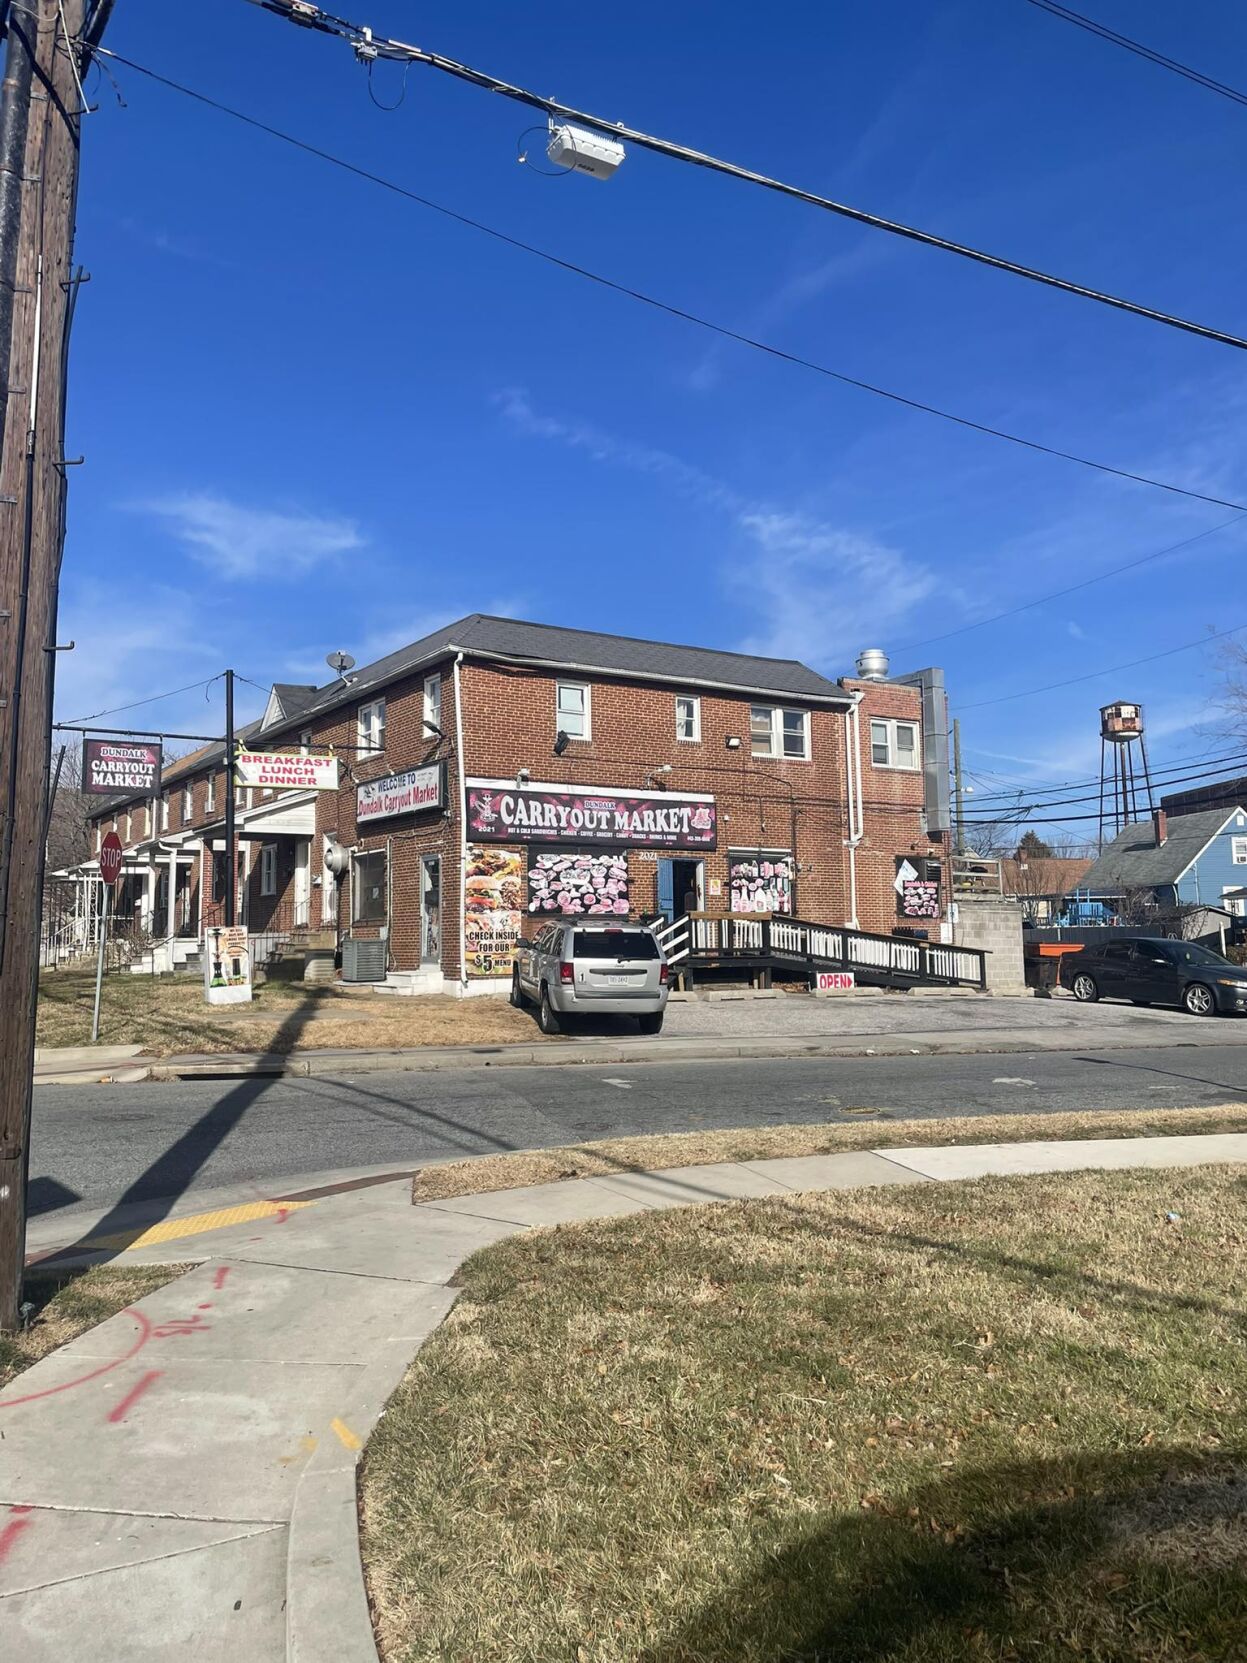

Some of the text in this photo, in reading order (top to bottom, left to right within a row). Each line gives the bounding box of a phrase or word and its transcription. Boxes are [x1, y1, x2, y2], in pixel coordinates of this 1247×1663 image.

[101, 748, 146, 759] DUNDALK
[242, 755, 332, 767] BREAKFAST
[91, 760, 155, 774] CARRYOUT
[262, 766, 315, 775] LUNCH
[91, 772, 153, 788] MARKET
[258, 775, 317, 785] DINNER
[378, 775, 406, 792] WELCOME
[407, 772, 416, 785] TO
[359, 783, 438, 816] Dundalk Carryout Market
[583, 800, 616, 810] DUNDALK
[500, 795, 692, 833] CARRYOUT MARKET
[101, 848, 121, 868] STOP
[639, 852, 657, 860] 2021
[469, 931, 519, 941] CHECK INSIDE
[479, 943, 510, 952] FOR OUR
[494, 959, 512, 967] MENU
[819, 974, 847, 989] OPEN
